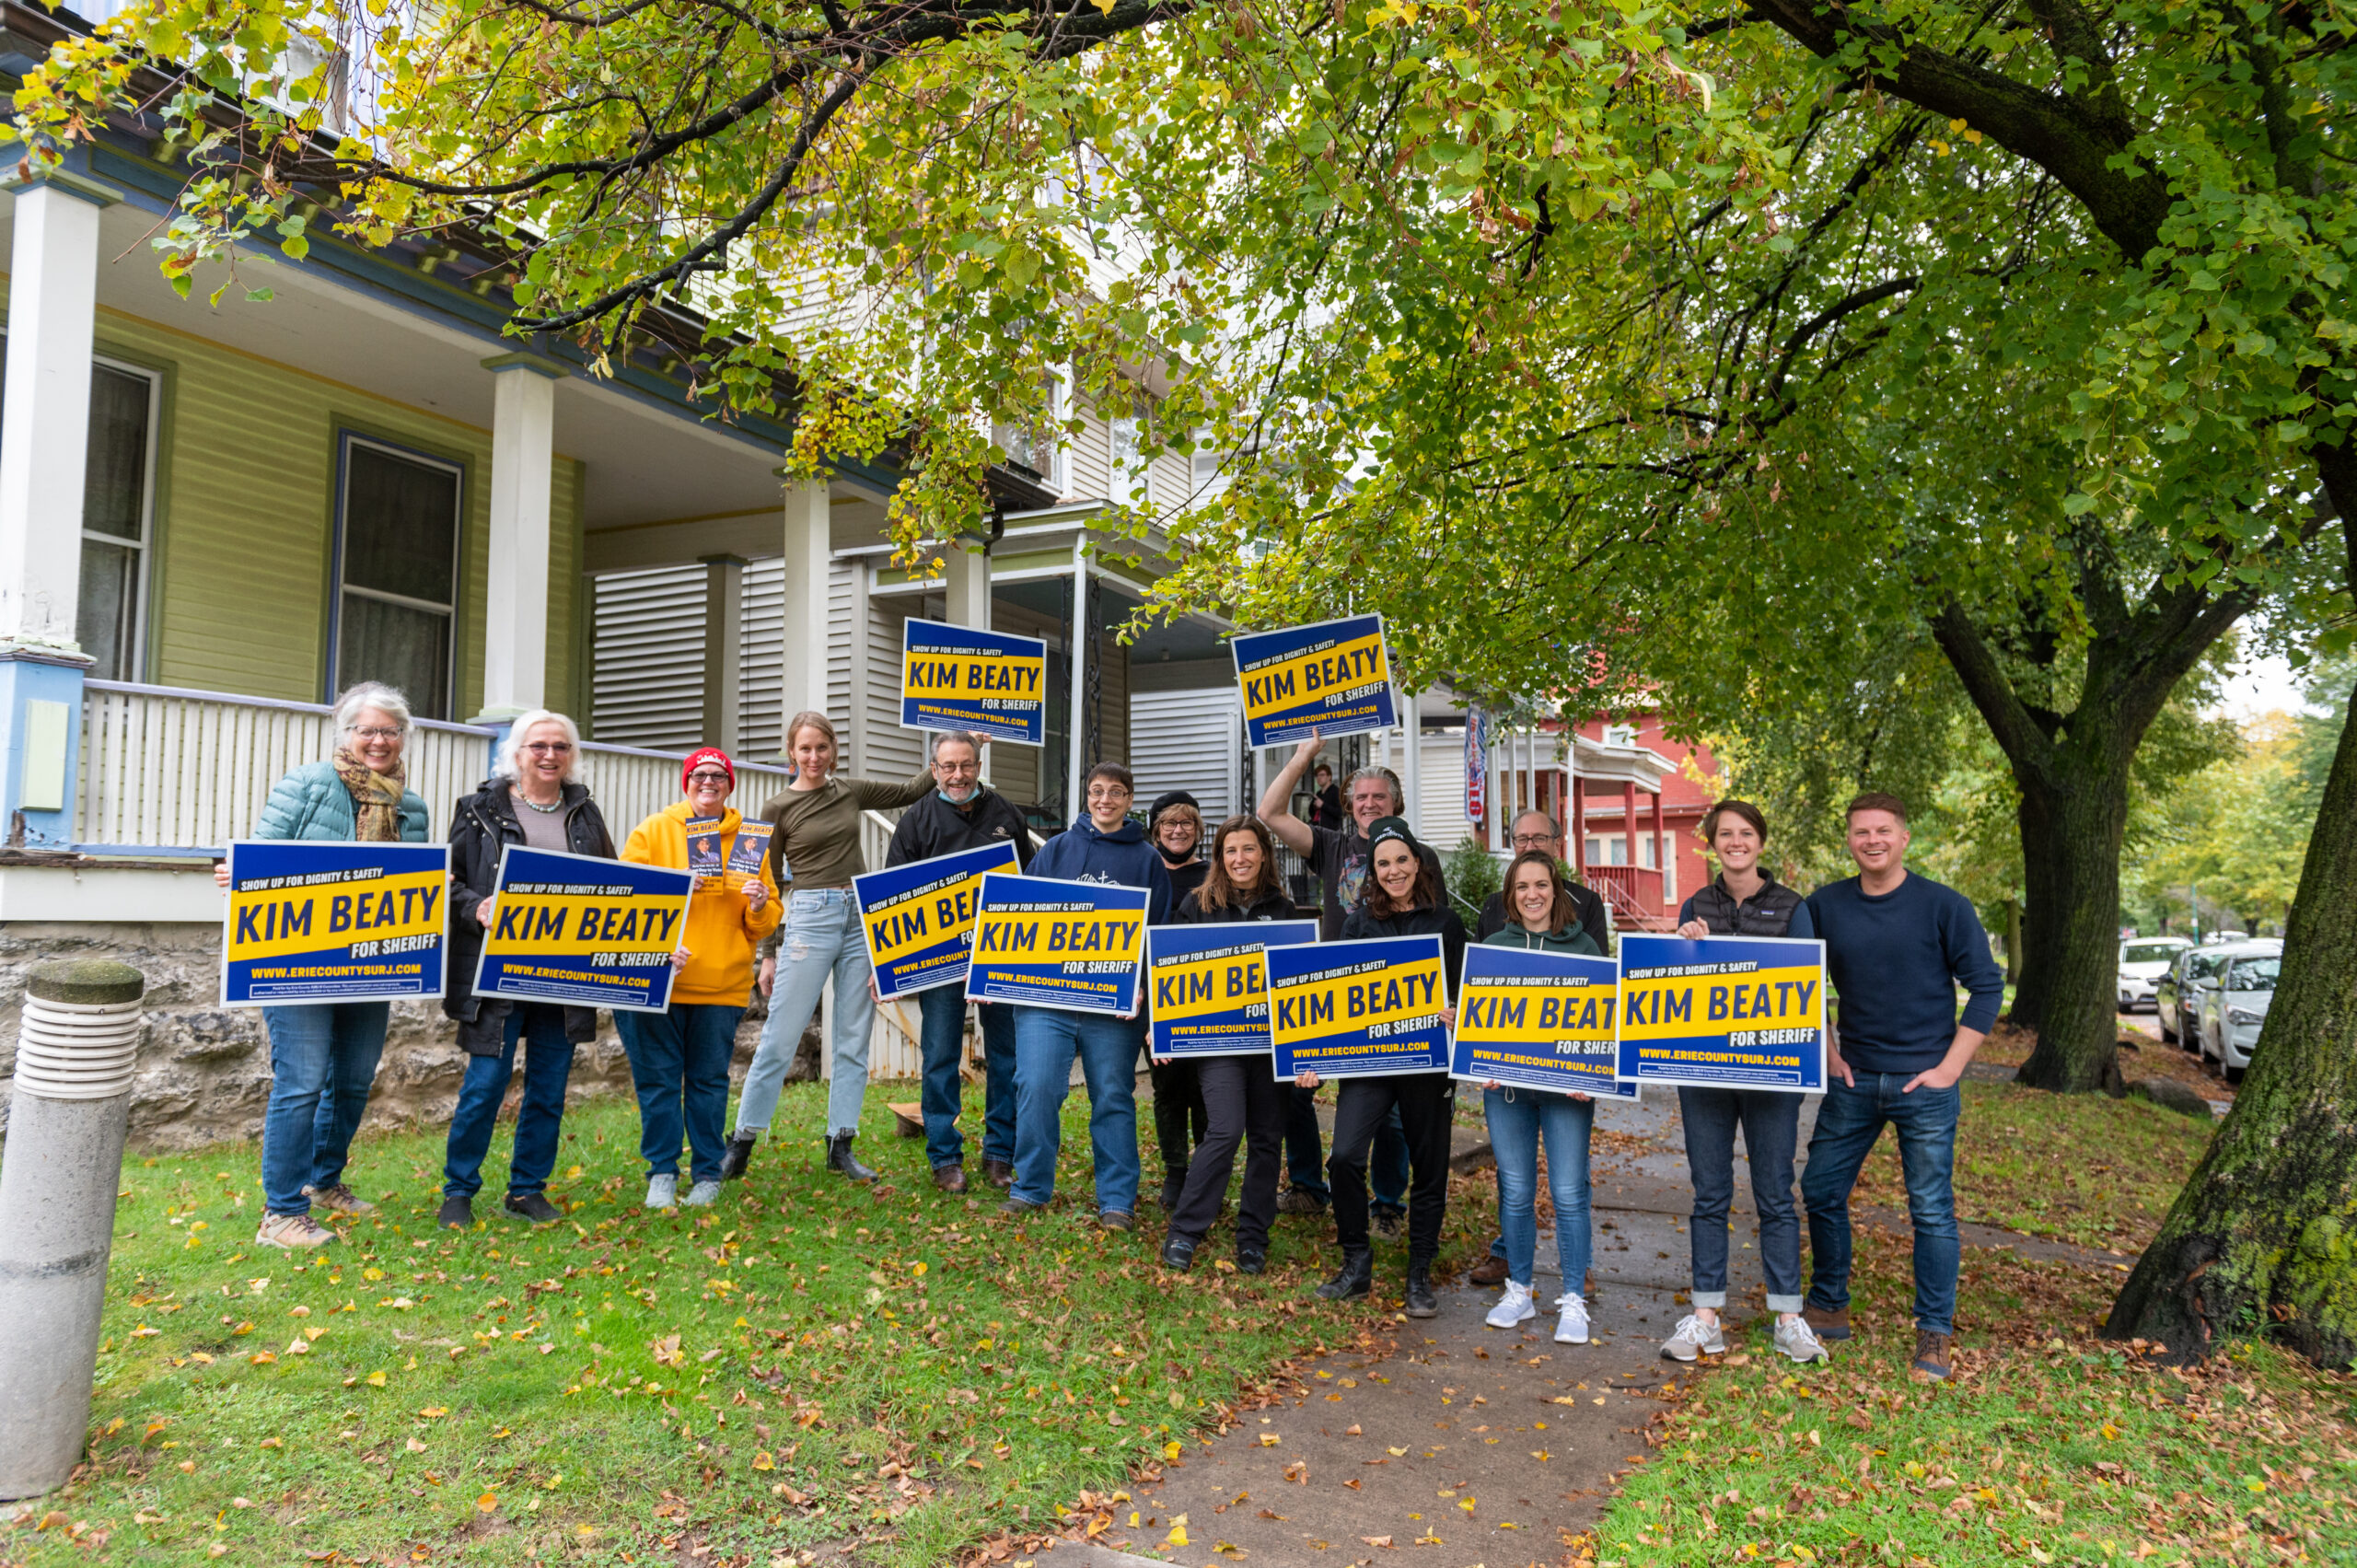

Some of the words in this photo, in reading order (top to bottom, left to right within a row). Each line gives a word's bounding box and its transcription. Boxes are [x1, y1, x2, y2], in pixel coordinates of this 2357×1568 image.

[1245, 660, 1260, 671] SHOW
[1262, 657, 1270, 666] UP
[1271, 655, 1283, 663] FOR
[1284, 646, 1306, 660] DIGNITY
[1315, 639, 1334, 651] SAFETY
[909, 661, 957, 688] KIM
[968, 664, 1039, 691] BEATY
[1247, 669, 1295, 707] KIM
[1305, 644, 1378, 691] BEATY
[981, 699, 999, 709] FOR
[1002, 699, 1038, 710] SHERIFF
[1325, 692, 1343, 707] FOR
[1346, 680, 1383, 701] SHERIFF
[918, 704, 1028, 726] WWW.ERIECOUNTYSURJ.COM
[1263, 704, 1377, 729] WWW.ERIECOUNTYSURJ.COM
[241, 879, 268, 891] SHOW
[271, 877, 284, 888] UP
[286, 876, 303, 886] FOR
[306, 871, 341, 884] DIGNITY
[343, 870, 351, 880] &
[353, 867, 382, 879] SAFETY
[507, 883, 532, 892] SHOW
[534, 884, 546, 892] UP
[547, 884, 563, 893] FOR
[563, 885, 597, 893] DIGNITY
[598, 886, 603, 894] &
[606, 886, 633, 895] SAFETY
[868, 900, 886, 912] SHOW
[888, 895, 897, 905] UP
[899, 890, 911, 901] FOR
[912, 881, 936, 897] DIGNITY
[946, 870, 967, 884] SAFETY
[236, 899, 313, 944] KIM
[329, 885, 440, 933] BEATY
[1062, 902, 1068, 911] &
[1070, 902, 1094, 911] SAFETY
[494, 905, 567, 939] KIM
[575, 907, 680, 941] BEATY
[872, 906, 926, 952] KIM
[935, 886, 980, 929] BEA
[351, 941, 377, 958] FOR
[382, 933, 436, 954] SHERIFF
[960, 929, 974, 945] FO
[980, 923, 1039, 950] KIM
[1048, 922, 1139, 950] BEATY
[590, 953, 617, 966] FOR
[619, 952, 668, 966] SHERIFF
[892, 948, 970, 975] WWW.ERIECOUNTY
[1158, 956, 1178, 966] SHOW
[1179, 954, 1189, 962] UP
[1190, 952, 1203, 960] FOR
[1205, 947, 1232, 958] DIGNITY
[1234, 946, 1239, 954] &
[1241, 942, 1264, 953] SAFETY
[251, 964, 421, 979] WWW.ERIECOUNTYSURJ.COM
[503, 963, 650, 987] WWW.ERIECOUNTYSURJ.COM
[1062, 961, 1085, 973] FOR
[1087, 961, 1132, 973] SHERIFF
[1277, 976, 1296, 987] SHOW
[1298, 974, 1307, 982] UP
[1310, 971, 1323, 981] FOR
[1325, 965, 1352, 978] DIGNITY
[1354, 964, 1360, 972] &
[1362, 959, 1386, 971] SAFETY
[1629, 969, 1652, 979] SHOW
[1655, 968, 1666, 976] UP
[1668, 967, 1682, 975] FOR
[1685, 964, 1717, 974] DIGNITY
[1720, 963, 1726, 972] &
[1729, 961, 1757, 971] SAFETY
[988, 971, 1117, 993] WWW.ERIECOUNTYSURJ.COM
[1157, 970, 1212, 1007] KIM
[1470, 977, 1492, 985] SHOW
[1554, 977, 1560, 985] &
[1562, 977, 1588, 985] SAFETY
[1246, 1003, 1266, 1017] FOR
[1278, 990, 1333, 1030] KIM
[1348, 970, 1437, 1017] BEATY
[1626, 988, 1692, 1025] KIM
[1708, 980, 1817, 1020] BEATY
[1463, 997, 1527, 1028] KIM
[1538, 997, 1616, 1029] BEAT
[1369, 1023, 1390, 1039] FOR
[1394, 1014, 1439, 1034] SHERIFF
[1729, 1031, 1755, 1046] FOR
[1759, 1028, 1814, 1045] SHERIFF
[1292, 1041, 1429, 1058] WWW.ERIECOUNTYSURJ.COM
[1555, 1040, 1580, 1053] FOR
[1583, 1040, 1615, 1054] SHER
[1639, 1049, 1799, 1066] WWW.ERIECOUNTYSURJ.COM
